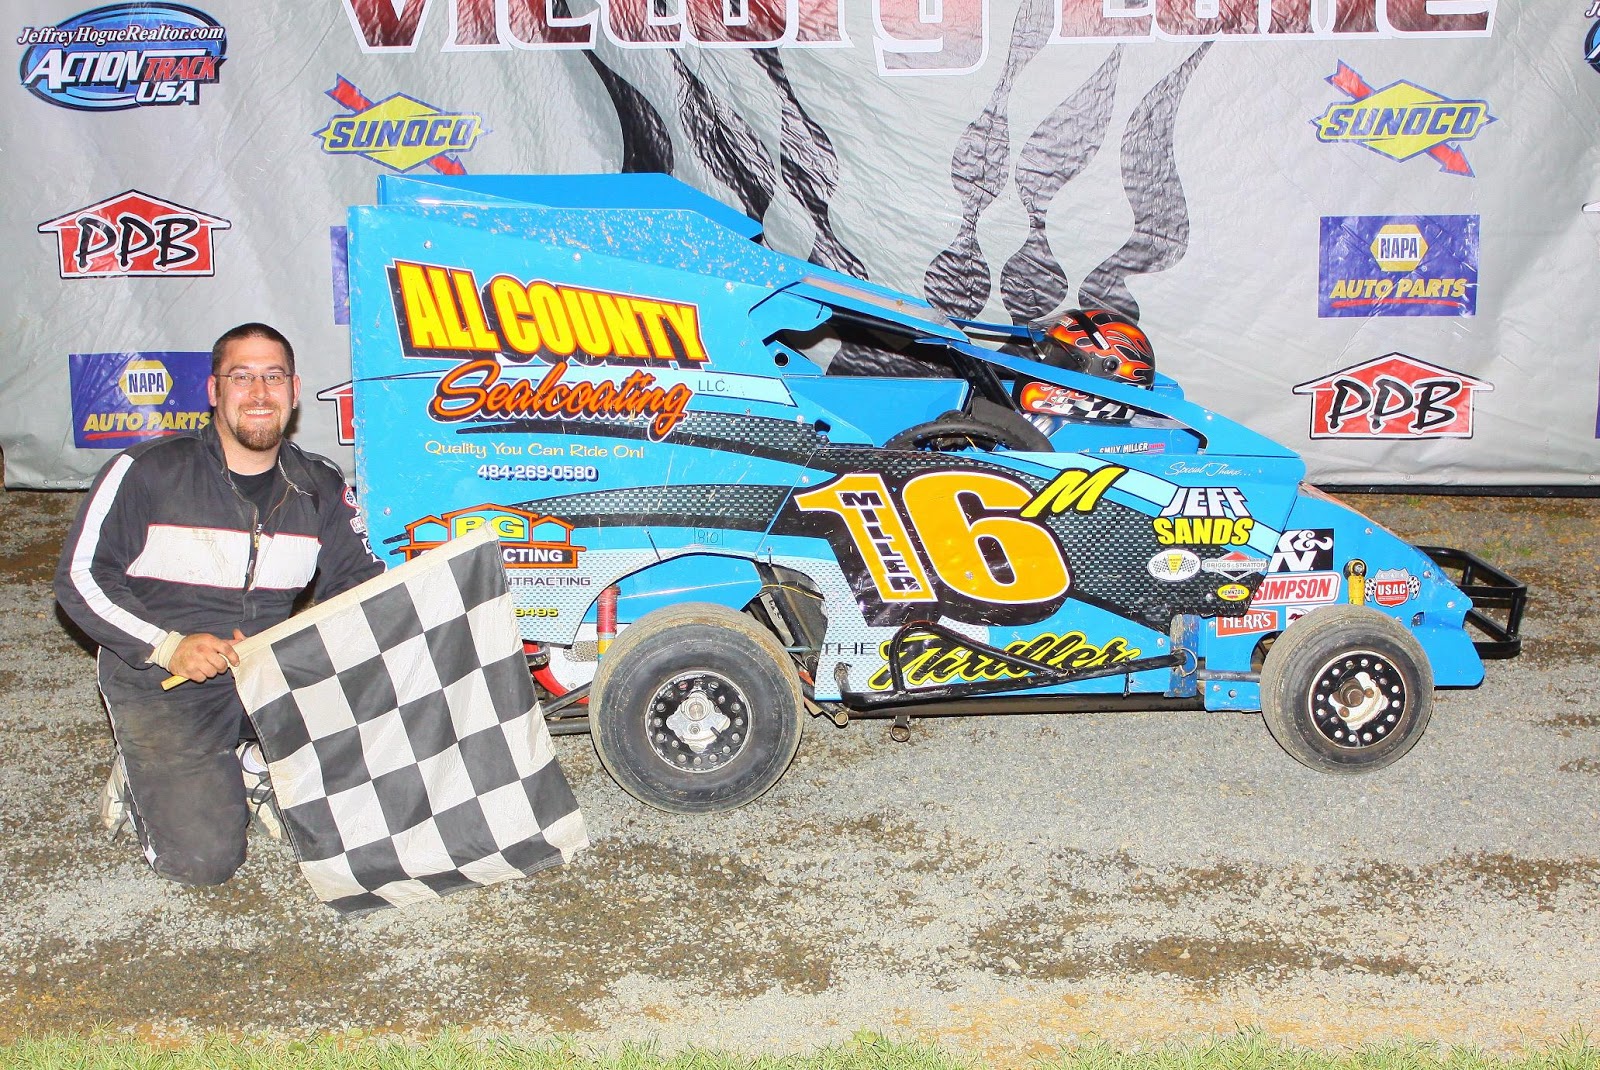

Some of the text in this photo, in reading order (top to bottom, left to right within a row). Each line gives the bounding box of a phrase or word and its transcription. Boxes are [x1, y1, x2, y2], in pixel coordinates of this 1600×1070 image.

[17, 25, 225, 46] JeffreyHogueRealtor.com
[23, 49, 219, 90] ACTION TRACK
[136, 81, 196, 104] USA
[329, 118, 477, 149] SUNOCO
[1324, 105, 1481, 140] SUNOCO
[75, 216, 198, 270] PPB
[1380, 237, 1418, 259] NAPA
[1329, 278, 1468, 299] AUTO PARTS
[389, 259, 710, 367] ALL COUNTY
[128, 372, 166, 394] NAPA
[429, 359, 693, 441] Sealcoating
[1327, 378, 1462, 430] PPB
[83, 411, 211, 432] AUTO PARTS
[424, 440, 487, 459] Quality
[491, 442, 522, 456] You
[527, 442, 565, 457] Can
[569, 444, 609, 458] Ride
[1122, 441, 1149, 454] MILLER
[476, 464, 599, 482] 484-269-0580
[1159, 487, 1252, 517] JEFF
[837, 490, 923, 593] MILLER
[1152, 516, 1255, 546] SANDS
[1206, 561, 1232, 569] BRIGGS
[1235, 561, 1267, 569] STRATTON
[1253, 578, 1332, 601] SIMPSON
[1377, 583, 1406, 596] USAC
[1222, 612, 1272, 630] HERR'S
[825, 642, 876, 656] THE
